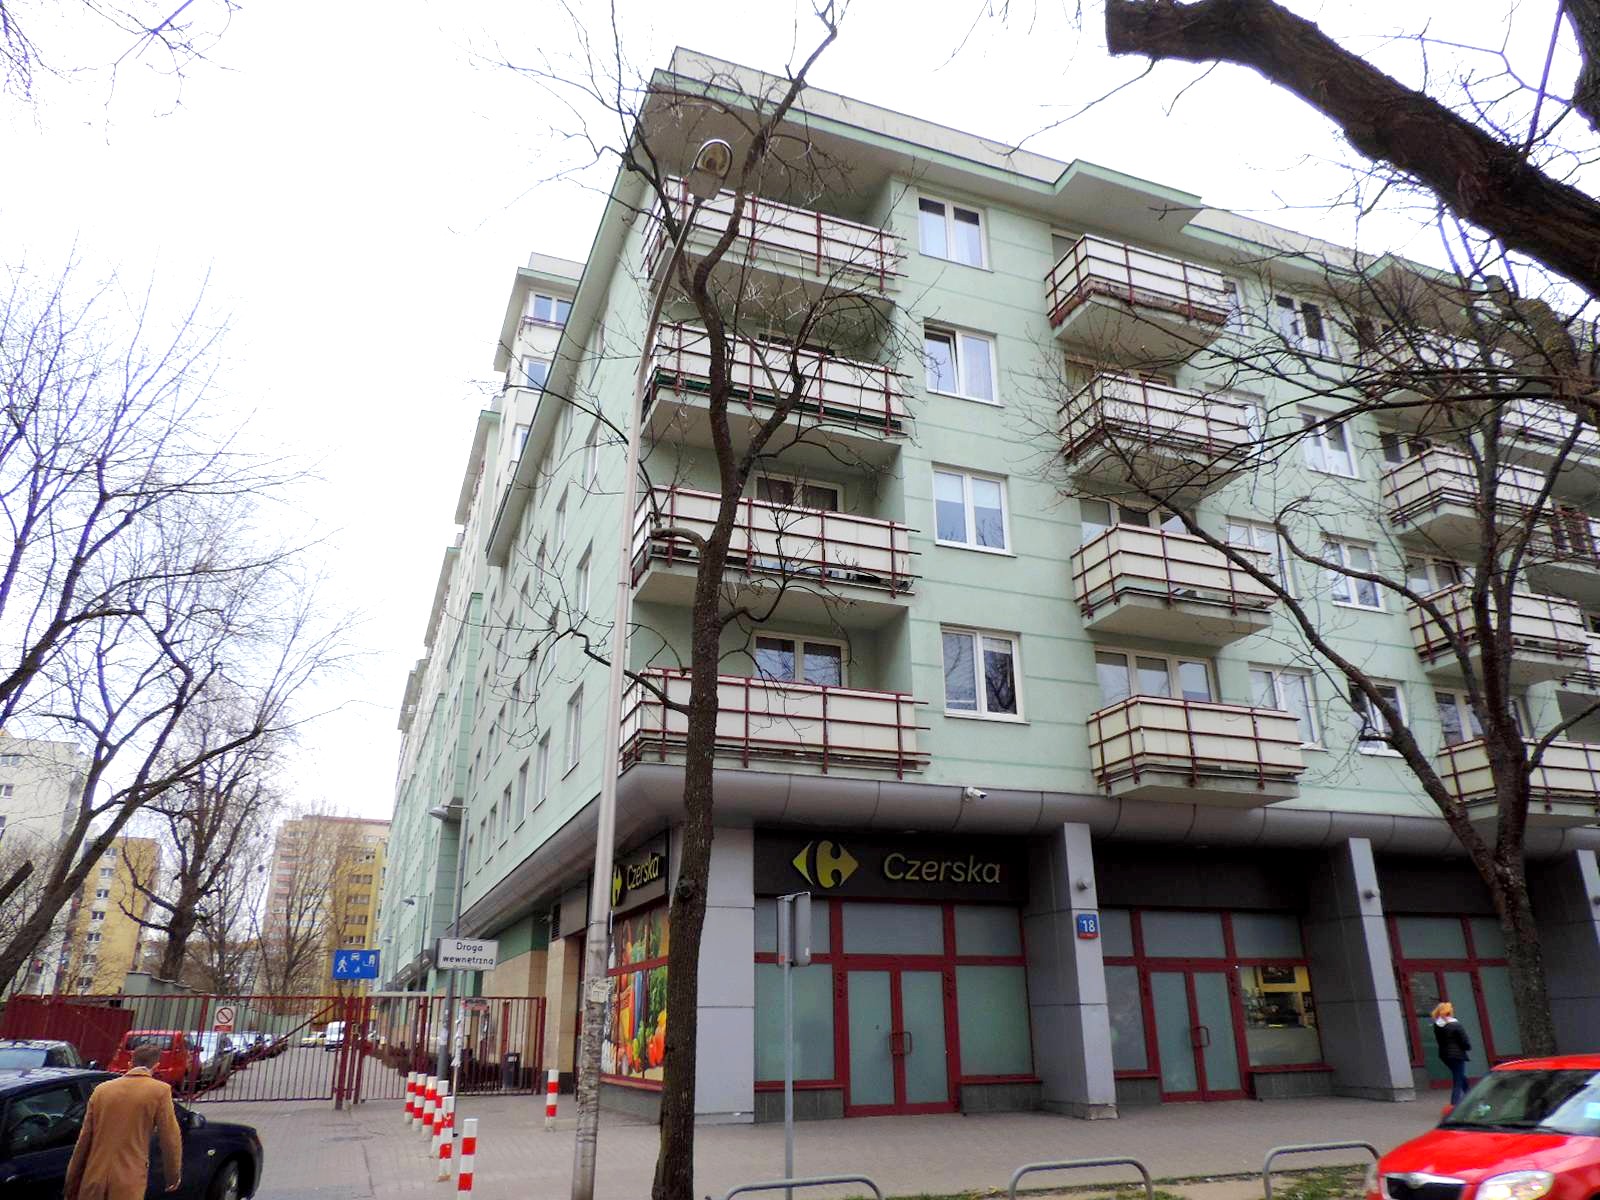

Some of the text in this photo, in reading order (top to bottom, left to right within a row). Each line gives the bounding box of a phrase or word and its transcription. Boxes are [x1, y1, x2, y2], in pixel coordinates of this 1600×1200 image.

[627, 851, 659, 890] Czerska
[884, 853, 1000, 883] Czerska
[1082, 919, 1095, 932] 18
[456, 942, 483, 953] Droga
